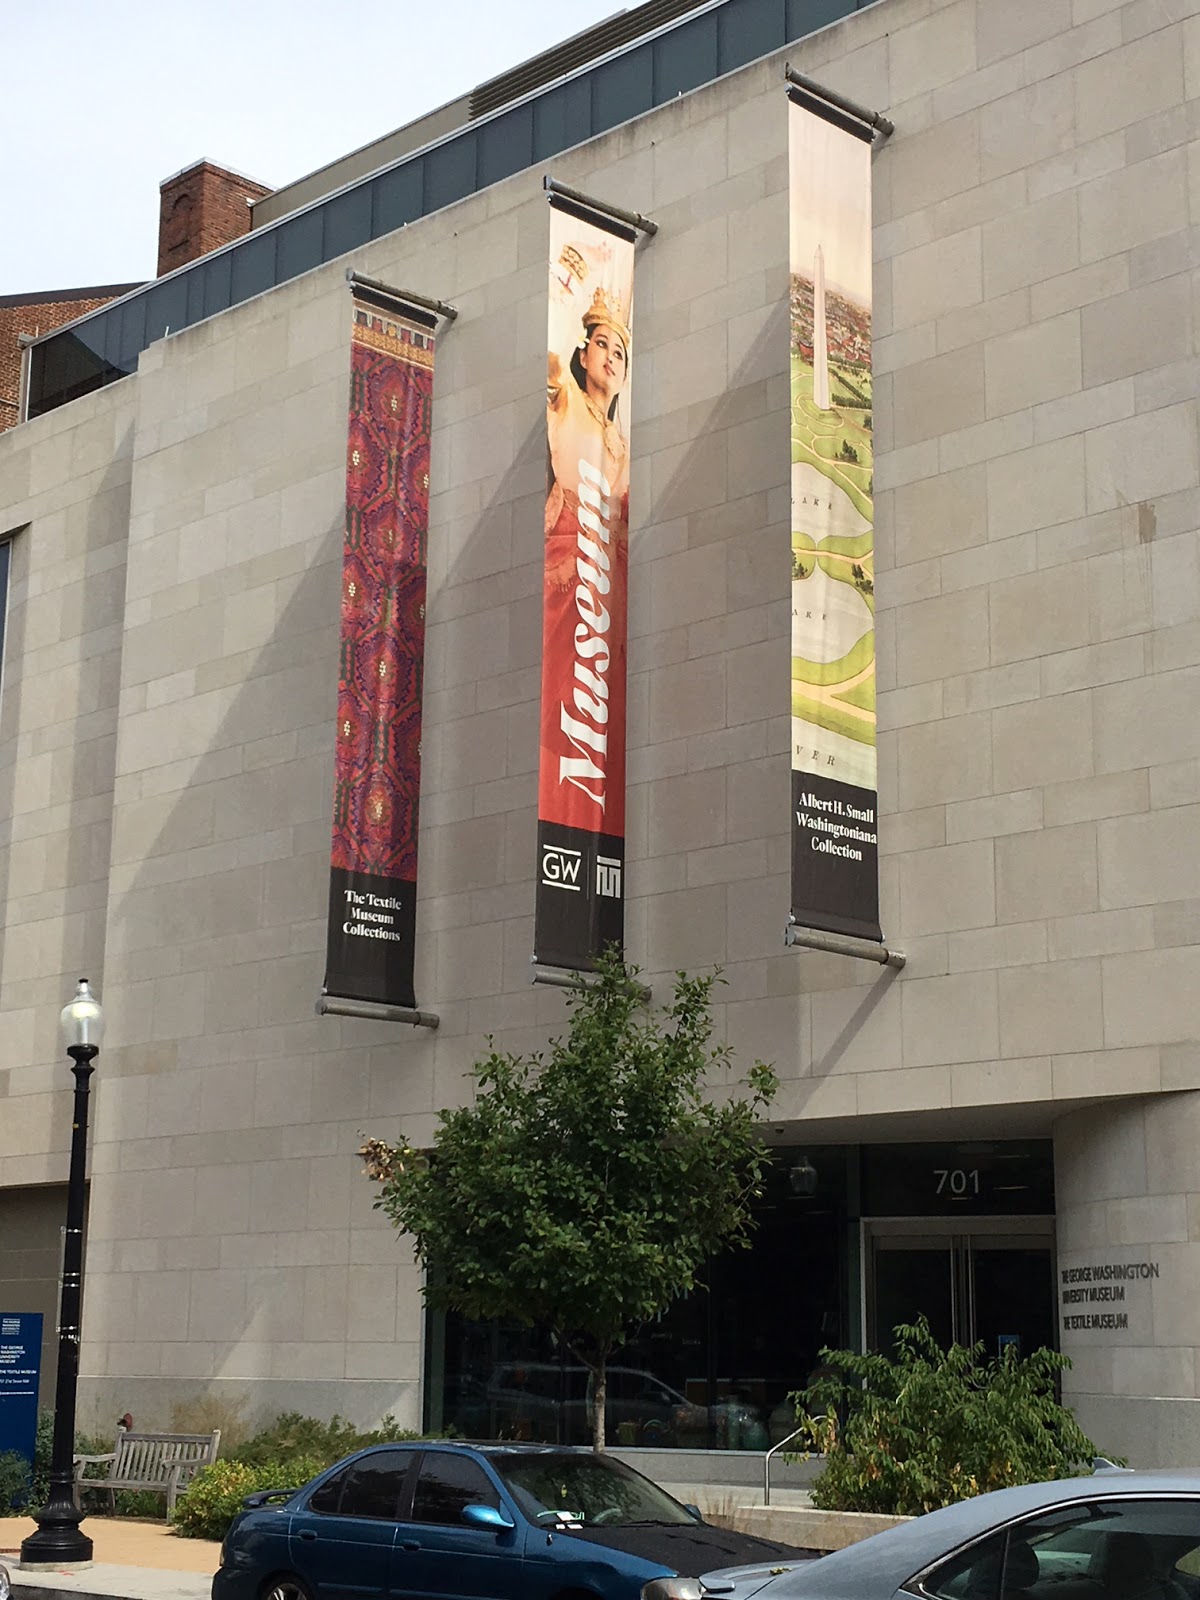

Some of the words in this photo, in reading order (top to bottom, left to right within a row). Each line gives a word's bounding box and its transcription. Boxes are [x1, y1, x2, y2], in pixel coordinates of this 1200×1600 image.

[559, 458, 611, 814] Museum
[799, 792, 832, 812] Albert
[834, 800, 846, 816] H.
[846, 804, 874, 823] Small
[796, 811, 877, 844] Washingtoniana
[811, 836, 862, 861] Collection
[542, 852, 581, 884] GW
[344, 889, 365, 904] The
[366, 893, 401, 910] Textile
[351, 907, 394, 925] Museum
[343, 921, 400, 941] Collections
[933, 1169, 980, 1194] 701
[1092, 1263, 1159, 1281] WASHINGTON
[1089, 1286, 1125, 1302] MUSEUM
[1091, 1313, 1128, 1329] MUSEUM
